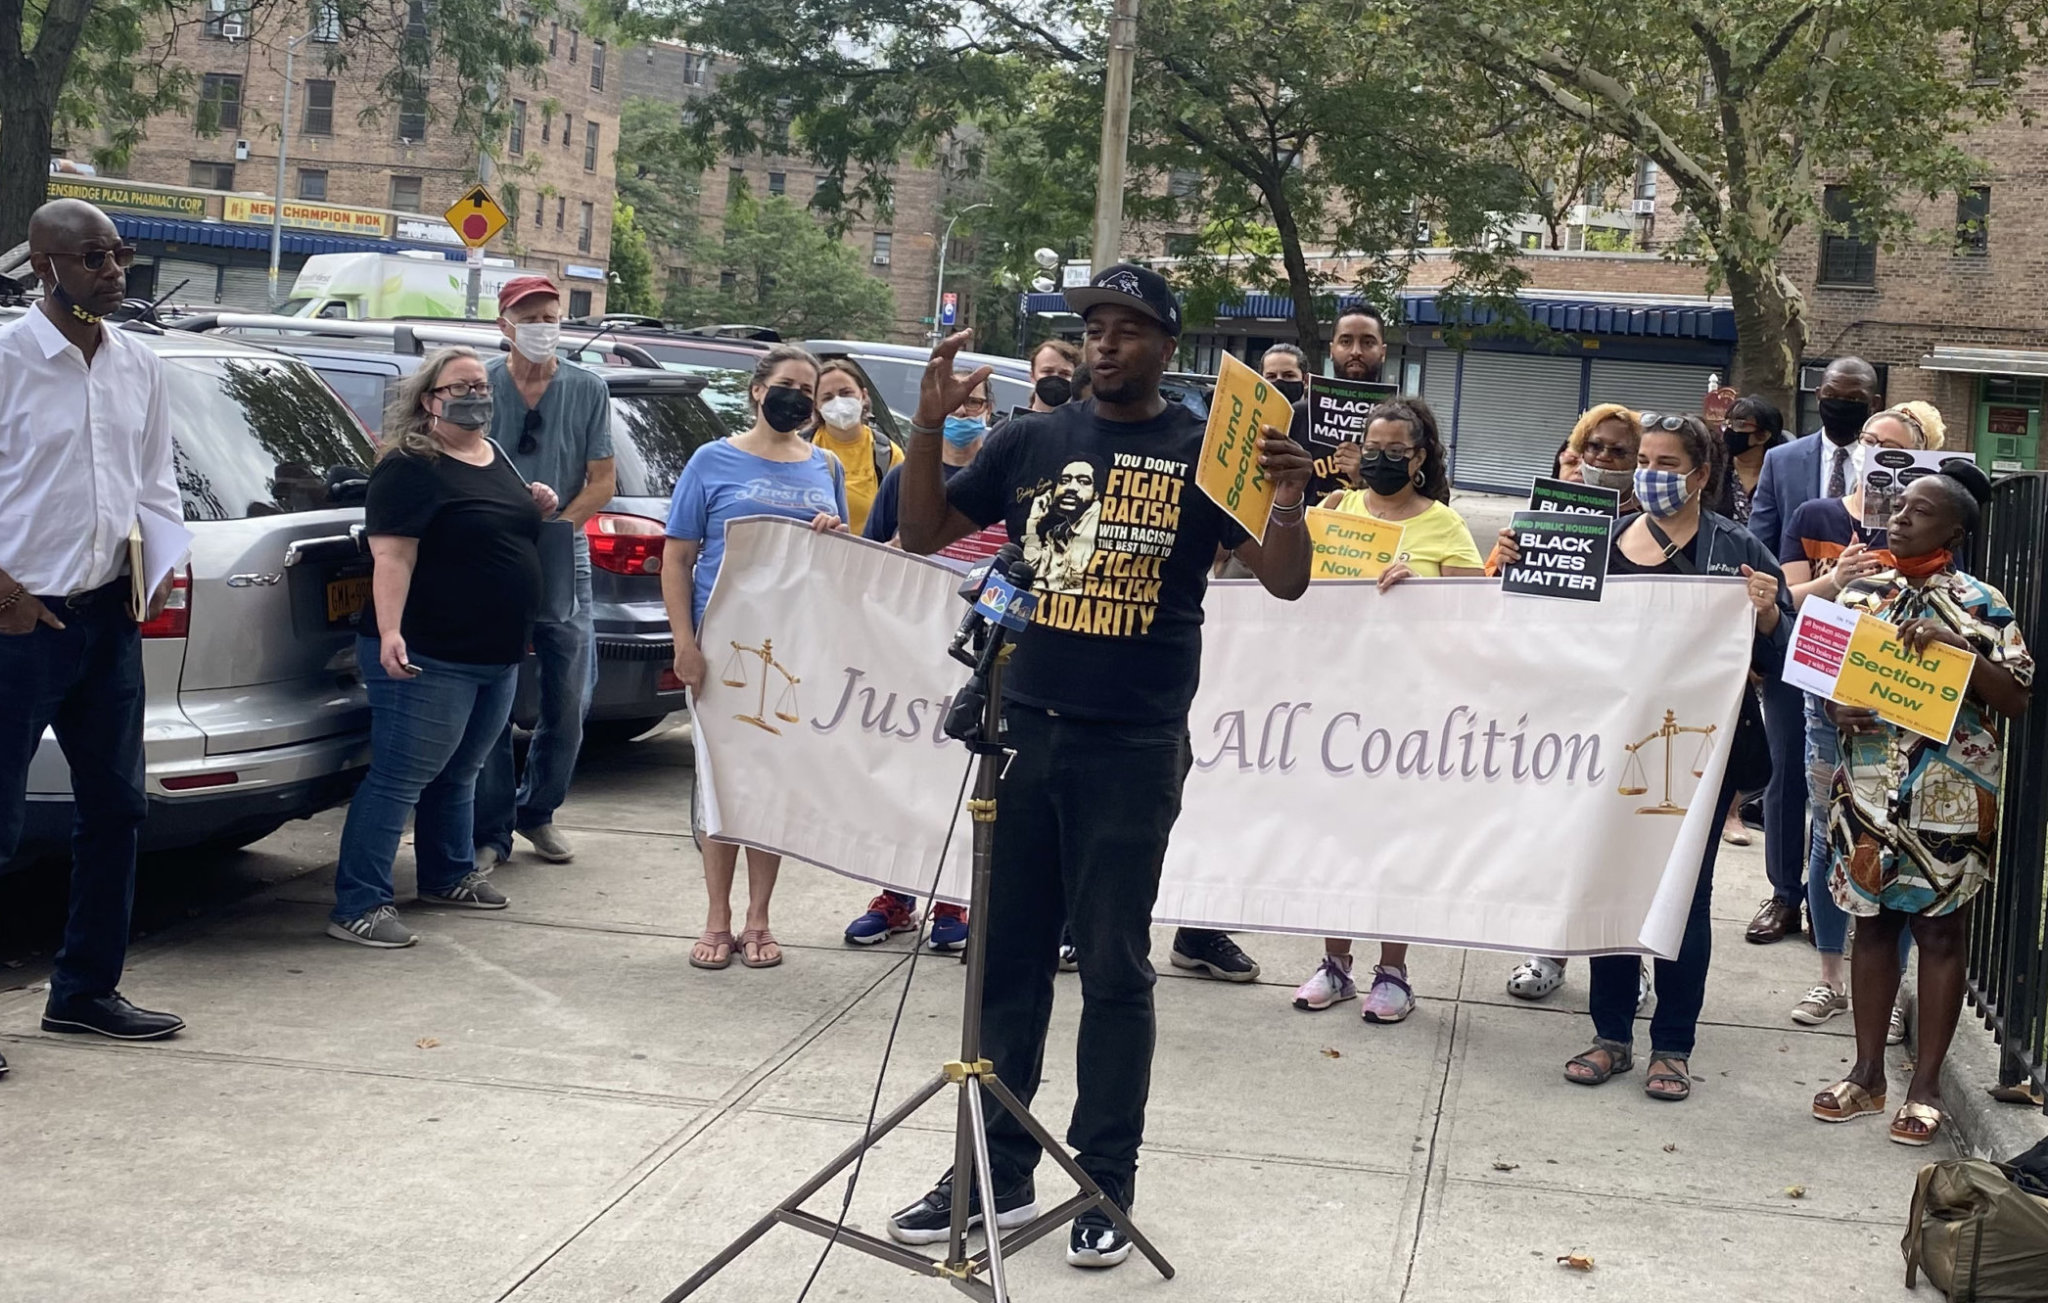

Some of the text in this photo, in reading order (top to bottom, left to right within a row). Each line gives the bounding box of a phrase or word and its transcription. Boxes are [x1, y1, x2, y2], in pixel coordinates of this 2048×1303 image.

[102, 189, 129, 204] PLAZA
[131, 192, 178, 209] PHARMACY
[179, 197, 202, 211] CORP
[283, 206, 351, 223] CHAMPION
[355, 214, 381, 226] WOK
[1331, 387, 1356, 398] PUBLIC
[1216, 394, 1243, 468] Fund
[1314, 424, 1365, 444] MATT
[1227, 408, 1262, 511] Section
[1254, 381, 1268, 404] 9
[1114, 453, 1188, 477] YOU DON'T
[1105, 468, 1184, 505] FIGHT
[1552, 489, 1577, 500] PUBLIC
[1100, 496, 1181, 531] RACISM
[1099, 524, 1176, 546] WITH RACISM
[1325, 524, 1376, 542] Fund
[1535, 521, 1564, 532] PUBLIC
[1097, 538, 1172, 558] THE BEST WAY TO
[1520, 533, 1594, 554] BLACK
[1087, 549, 1166, 579] FIGHT
[1376, 551, 1391, 563] 9
[1525, 551, 1586, 571] LIVES
[1320, 560, 1362, 577] Now
[1509, 568, 1597, 591] MATTER
[1083, 575, 1162, 603] RACISM
[1030, 588, 1157, 636] LIDARITY
[1879, 640, 1940, 673] Fund
[1848, 651, 1935, 694] Section
[1940, 686, 1959, 702] 9
[1869, 682, 1924, 711] Now
[810, 666, 1606, 783] Just All Coalition
